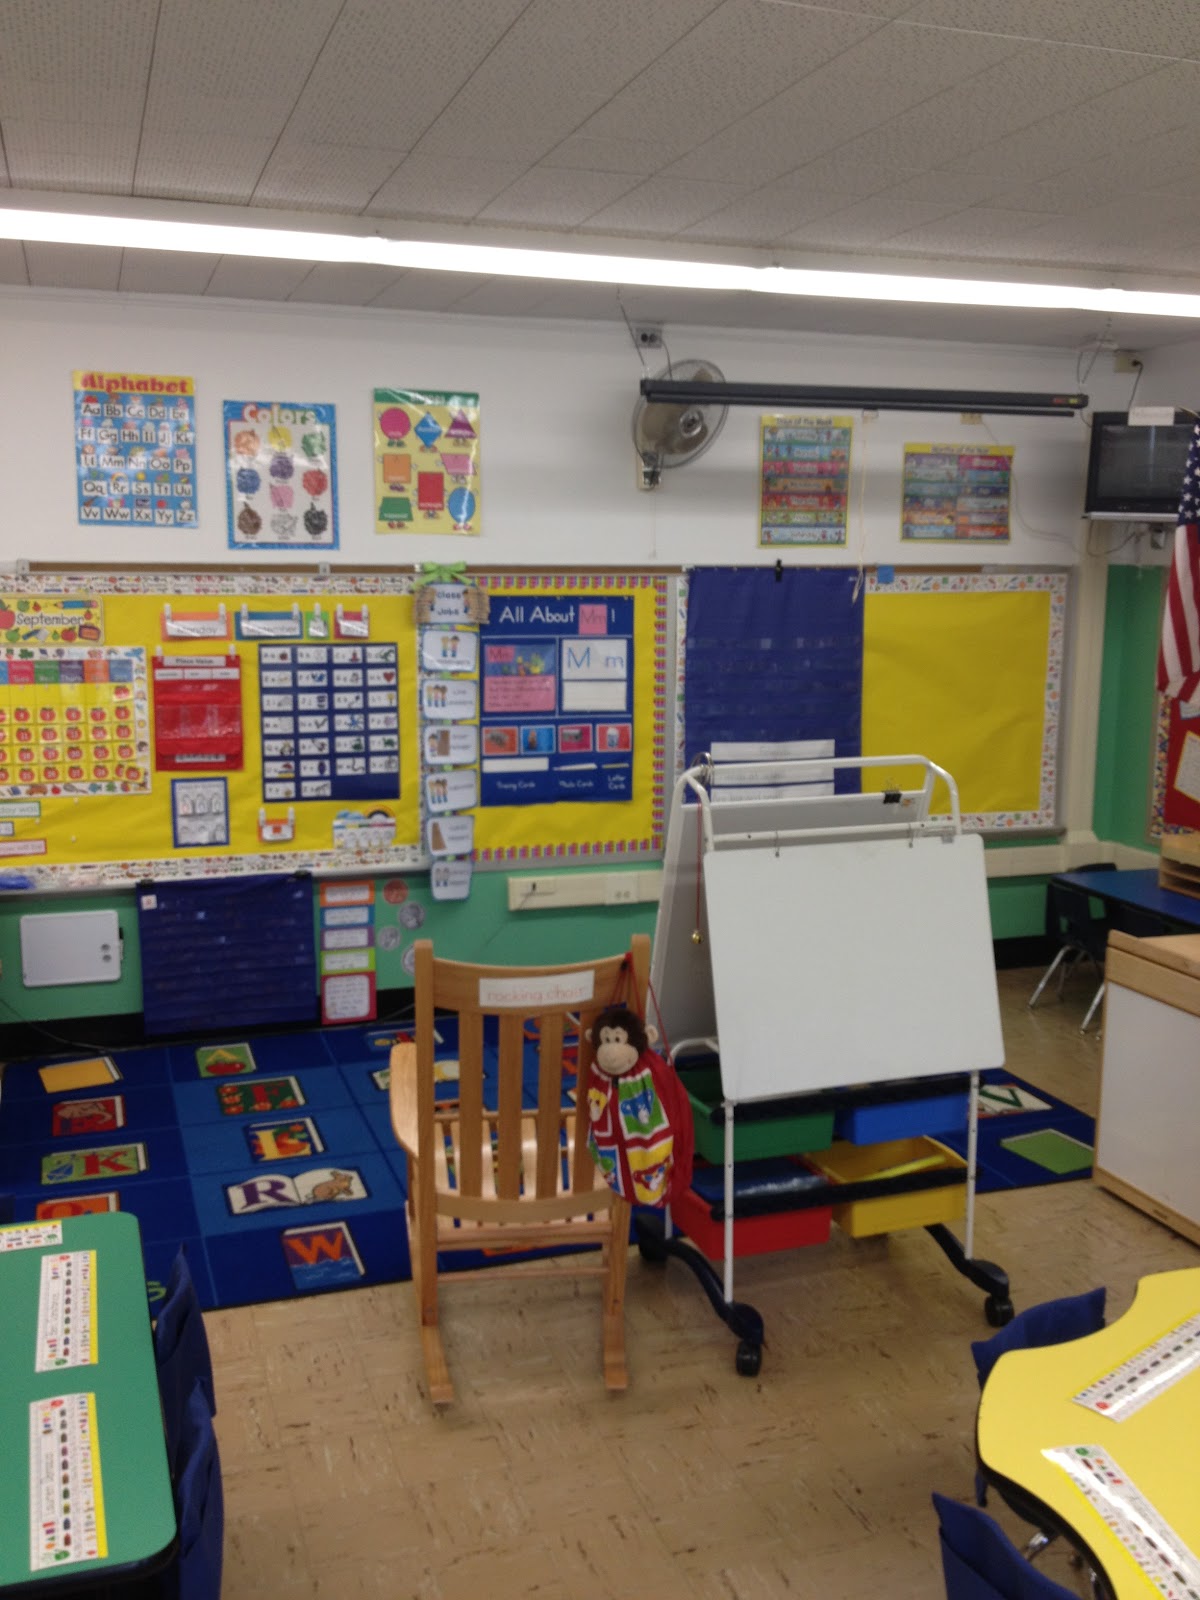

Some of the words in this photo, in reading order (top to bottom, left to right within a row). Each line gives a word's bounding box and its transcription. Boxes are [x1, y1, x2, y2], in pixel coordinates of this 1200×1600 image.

[82, 373, 188, 394] Alphabet
[83, 404, 100, 415] Aa
[106, 405, 121, 416] Bb
[127, 406, 144, 417] Cc
[149, 407, 165, 418] Dd
[243, 403, 317, 424] Colors
[122, 429, 138, 440] Hh
[176, 433, 190, 443] Kk
[102, 456, 124, 466] Mm
[150, 458, 169, 469] Oo
[175, 460, 190, 472] Pp
[113, 482, 125, 493] Rr
[156, 483, 168, 494] Tt
[175, 484, 191, 495] Uu
[83, 508, 98, 518] Vv
[105, 509, 129, 519] Ww
[135, 510, 151, 520] Xx
[157, 511, 172, 522] Yy
[179, 512, 193, 522] Zz
[437, 591, 461, 599] Class
[16, 612, 84, 628] September
[437, 608, 460, 616] Jobs
[499, 606, 524, 623] All
[529, 605, 575, 623] About
[568, 646, 591, 668] M
[604, 655, 624, 668] m
[488, 985, 543, 1002] rocking
[546, 983, 585, 998] chair
[80, 1150, 134, 1177] K
[237, 1179, 301, 1209] R
[286, 1231, 343, 1265] W
